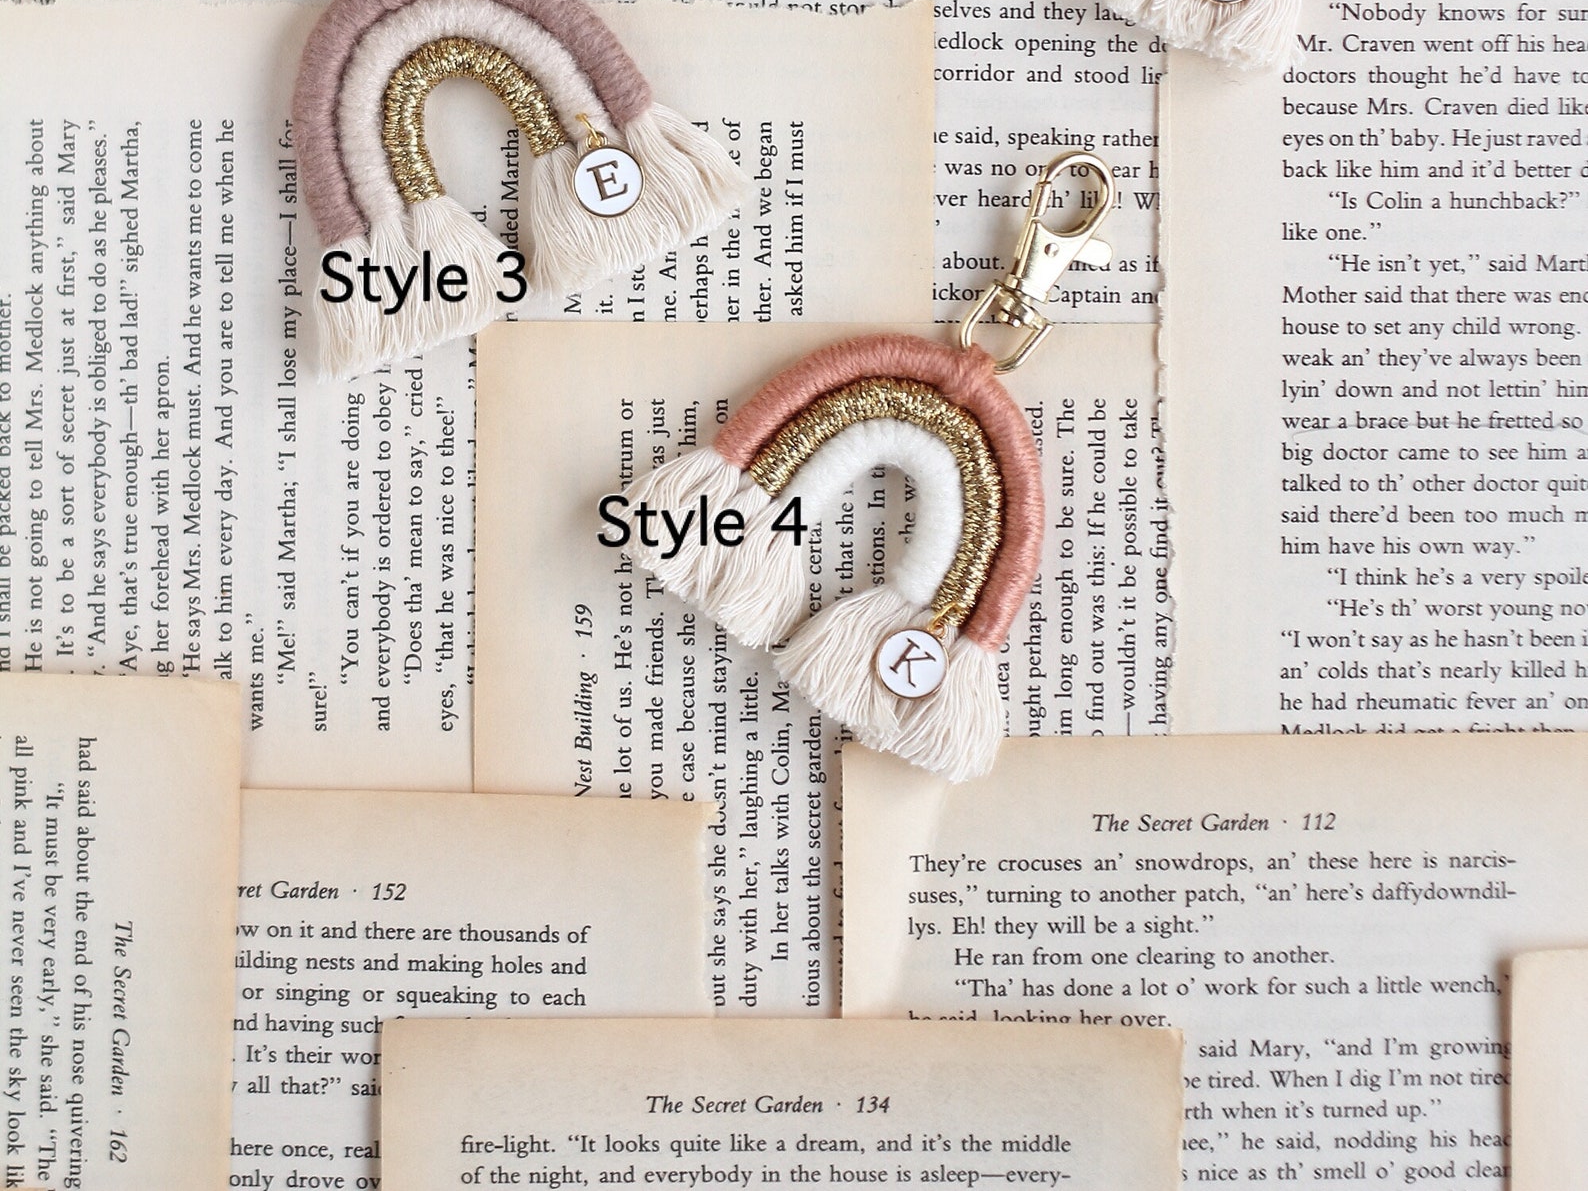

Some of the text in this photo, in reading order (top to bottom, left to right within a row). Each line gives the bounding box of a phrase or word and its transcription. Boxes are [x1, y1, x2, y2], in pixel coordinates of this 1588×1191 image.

[586, 160, 628, 202] E
[1328, 191, 1580, 209] “Is Colin a hunchback?”
[1281, 222, 1381, 241] like one.”
[150, 356, 175, 653] her forehead with her apron.
[1280, 536, 1535, 559] him have his own way.”
[889, 637, 937, 688] K
[308, 672, 327, 732] sure!”
[573, 602, 598, 796] Nest Building 159
[1092, 812, 1336, 832] The Secret Garden 112
[739, 670, 764, 1008] duty with her,” laughing a little.
[909, 850, 1517, 877] They’re crocuses an’ snowdrops, an’ these here is narcis-
[269, 880, 408, 901] Garden 152
[63, 737, 97, 1190] had said about the end of his nose quivering
[240, 982, 587, 1010] or singing or squeaking to each
[109, 921, 134, 1163] The Secret Garden 162
[646, 1095, 890, 1114] The Secret Garden 134
[460, 1133, 1072, 1159] fire-light. “It looks quite like a dream, and it’s the middle
